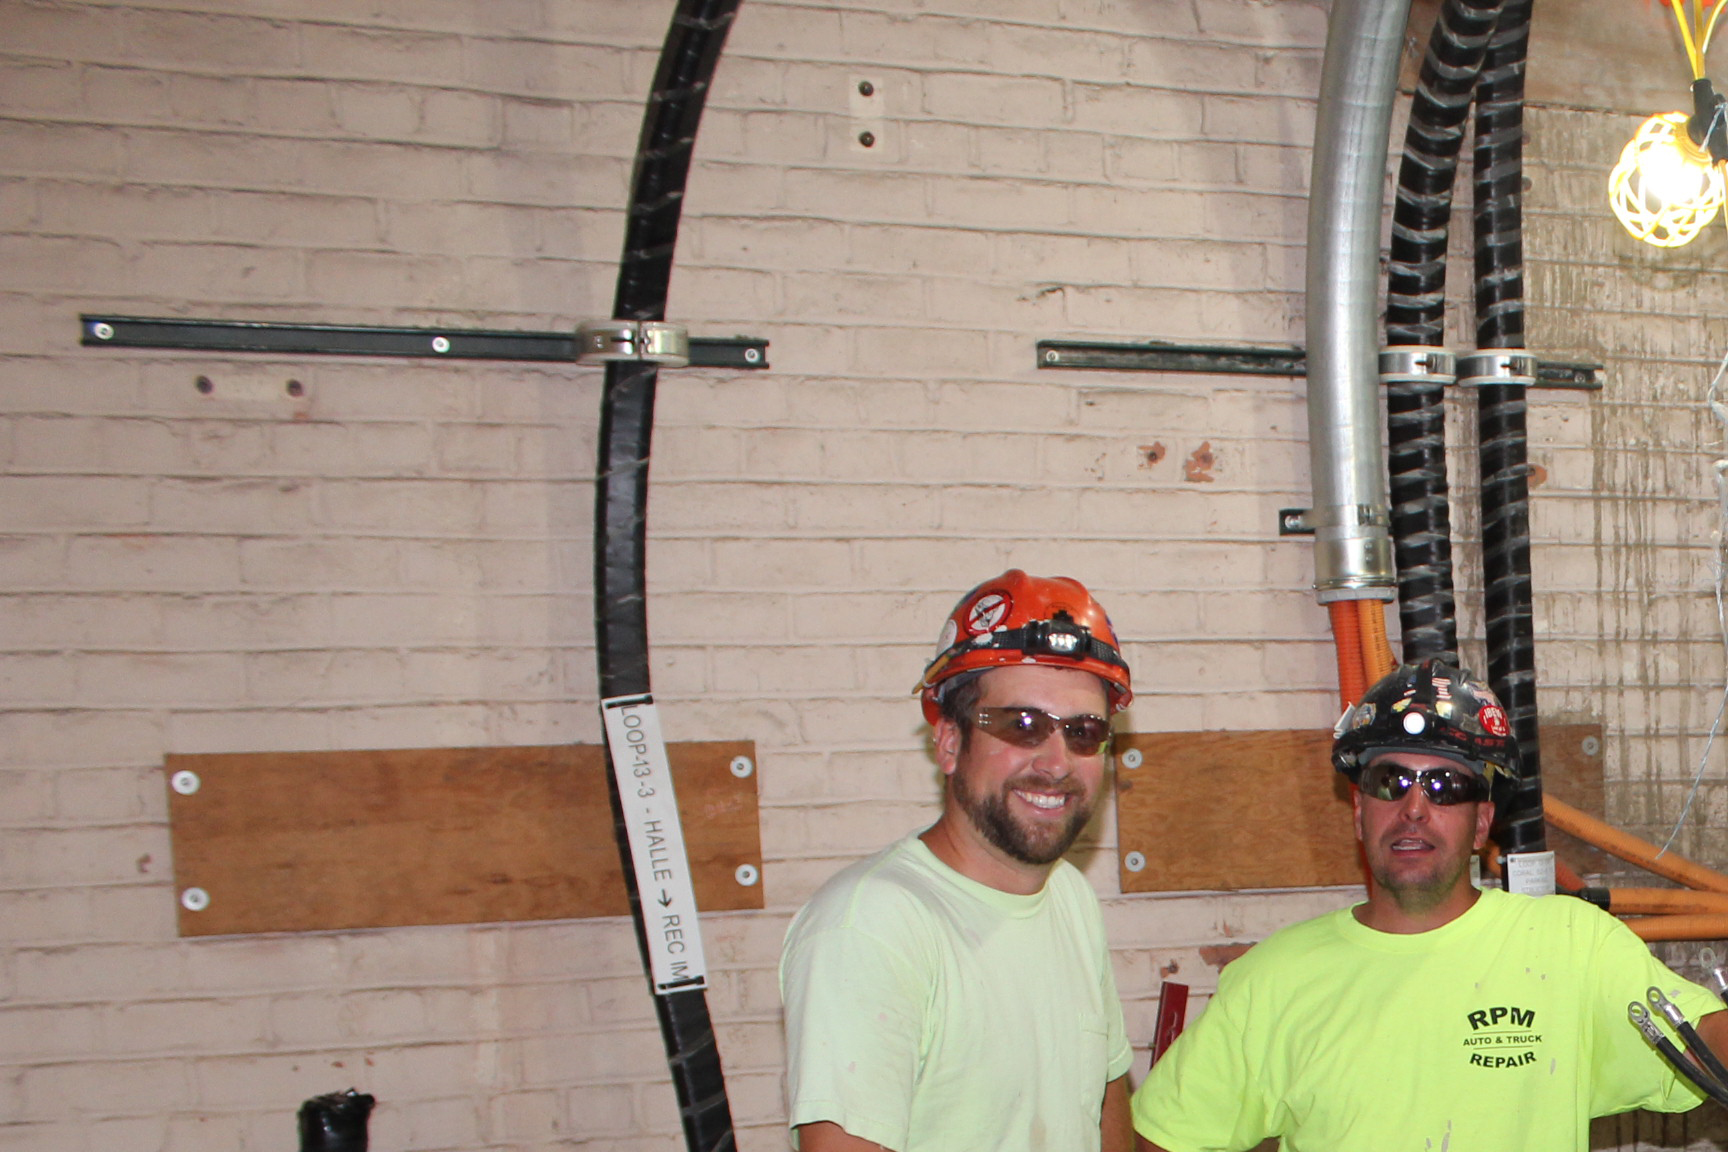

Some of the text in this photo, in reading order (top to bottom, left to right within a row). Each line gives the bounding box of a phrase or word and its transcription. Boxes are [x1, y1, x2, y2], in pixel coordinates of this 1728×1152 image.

[1484, 707, 1503, 719] IBEW
[643, 820, 673, 882] HALLE
[661, 914, 686, 955] REC
[1467, 1006, 1536, 1031] RPM
[1462, 1034, 1543, 1046] AUTO & TRUCK
[1469, 1051, 1538, 1068] REPAIR
